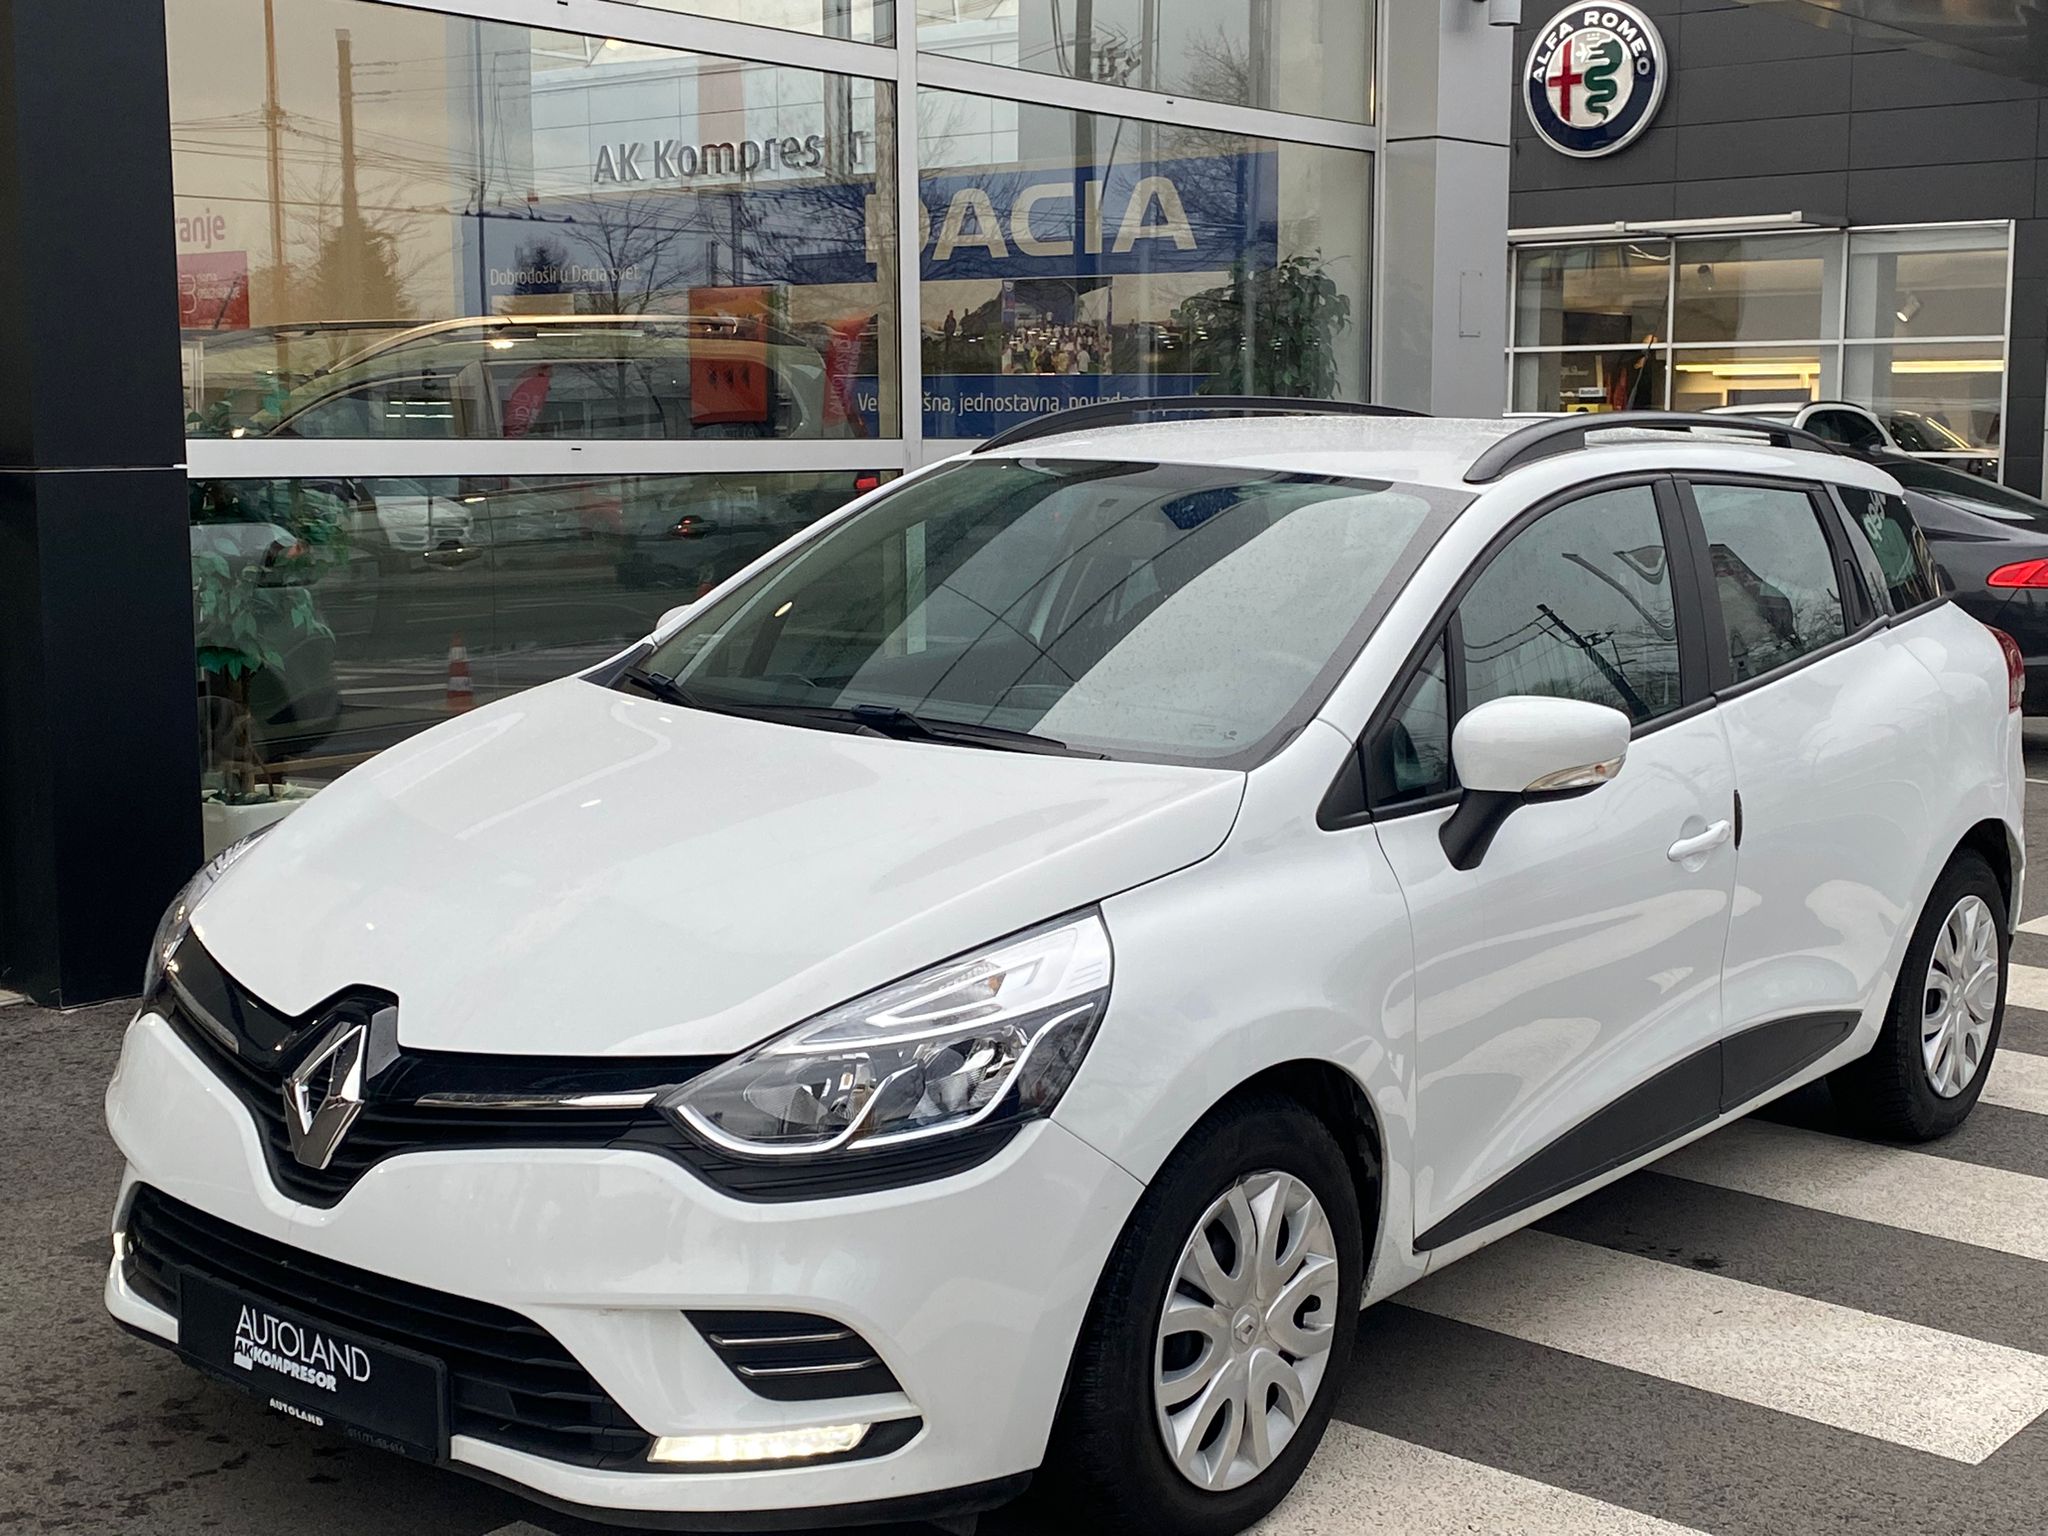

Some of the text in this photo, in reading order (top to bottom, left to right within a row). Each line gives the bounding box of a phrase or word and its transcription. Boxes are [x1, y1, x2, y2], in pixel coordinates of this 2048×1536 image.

[1533, 11, 1651, 83] ALFA ROMEO
[593, 129, 871, 183] AK Kompresr
[490, 264, 557, 286] Dobrodošli
[560, 271, 568, 282] u
[572, 264, 607, 283] Dacia
[958, 391, 1064, 416] jednostavna,
[236, 1304, 371, 1382] AUTOLAND
[250, 1345, 338, 1393] KOMPRESOR
[269, 1397, 325, 1427] AUTOLAND
